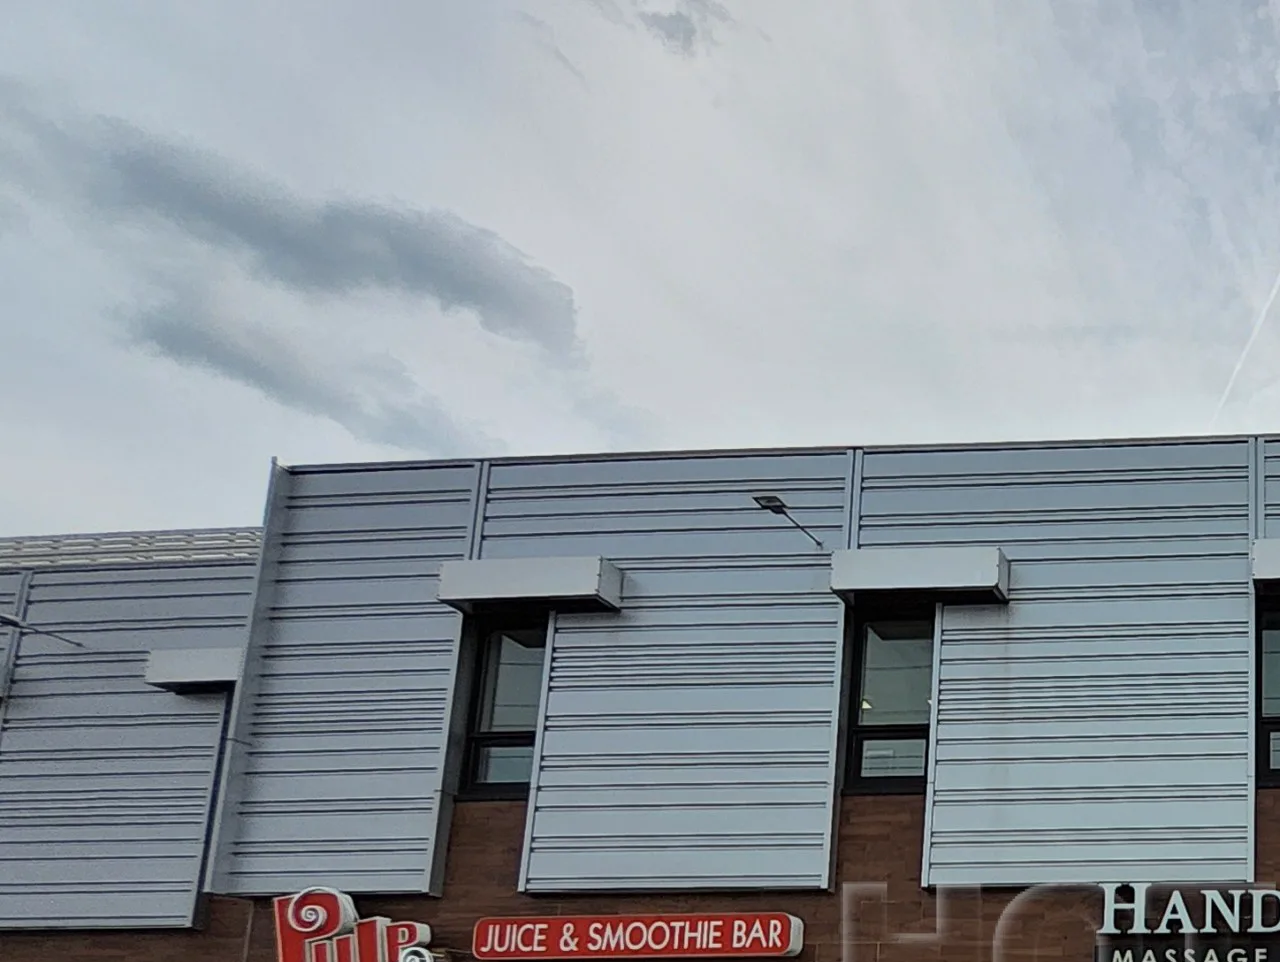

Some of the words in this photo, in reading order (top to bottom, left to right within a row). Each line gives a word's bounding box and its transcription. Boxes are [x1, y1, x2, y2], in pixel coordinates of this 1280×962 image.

[479, 924, 548, 952] JUICE
[559, 923, 578, 951] &
[587, 920, 723, 950] SMOOTHIE
[732, 919, 782, 948] BAR
